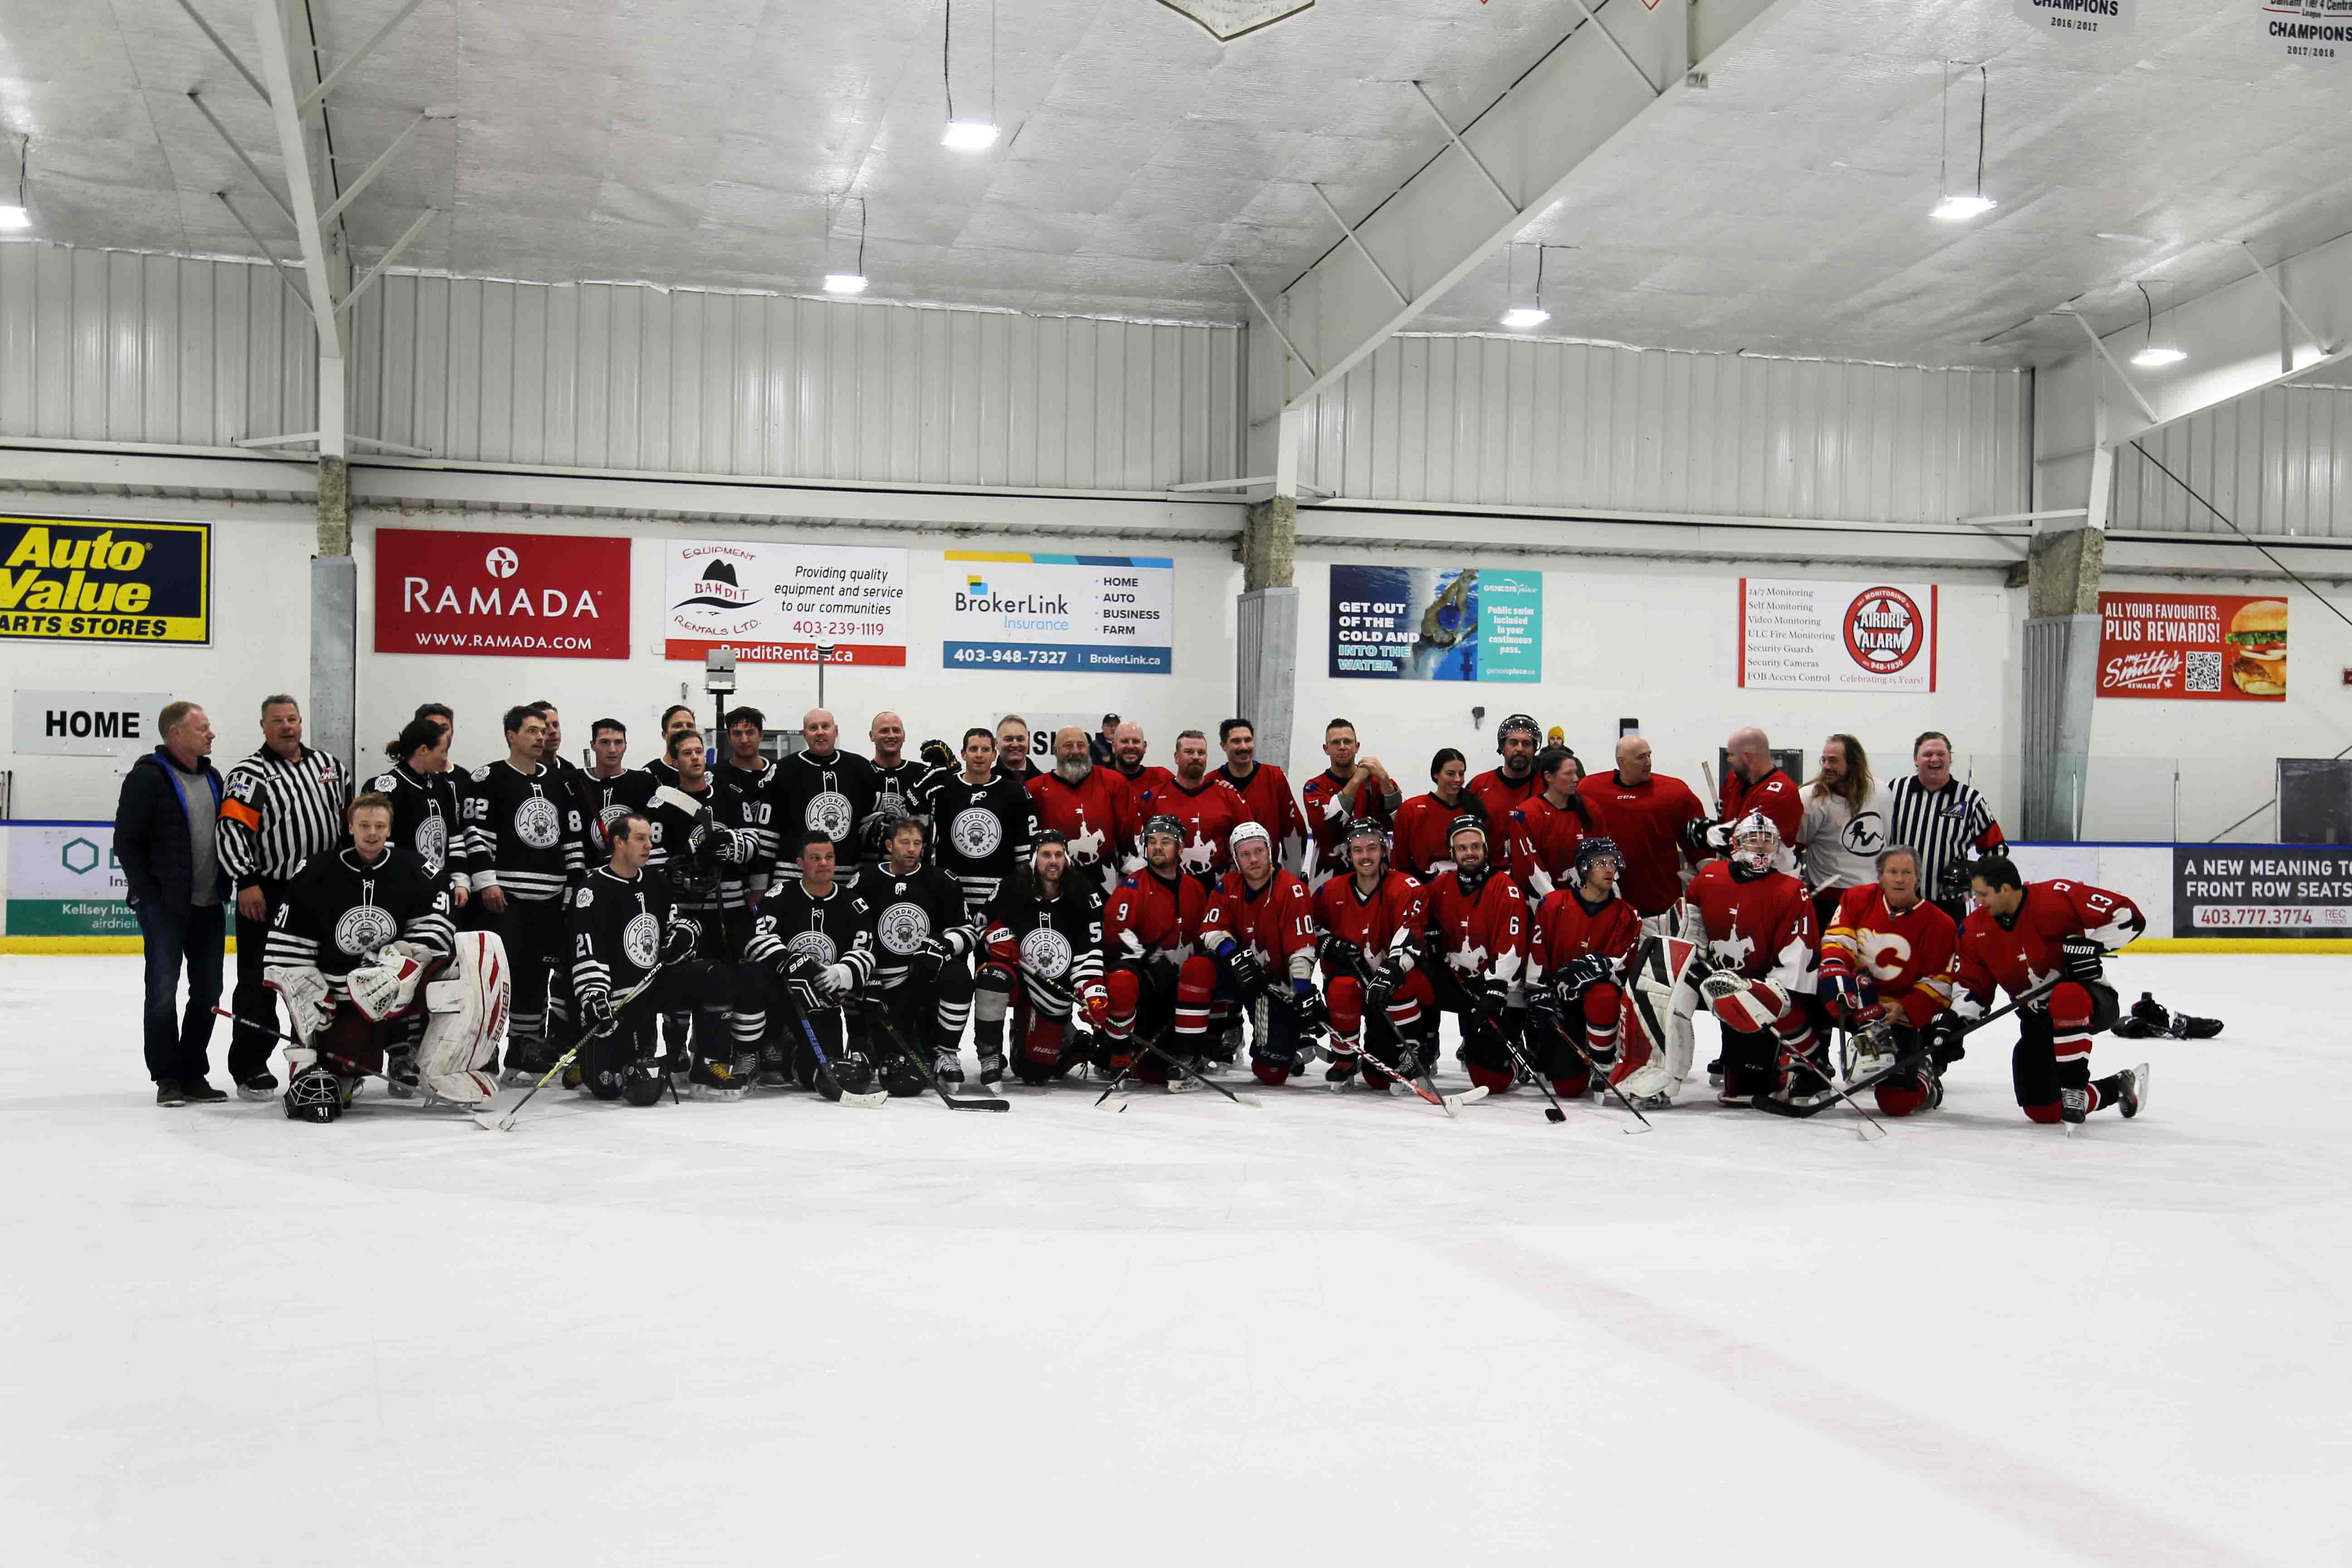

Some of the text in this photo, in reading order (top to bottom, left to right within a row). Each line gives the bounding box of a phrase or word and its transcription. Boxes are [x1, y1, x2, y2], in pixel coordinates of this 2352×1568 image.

[2051, 17, 2098, 32] 2016/2017
[2287, 45, 2335, 57] 2017/2018
[682, 546, 756, 561] EQUIPMENT
[795, 566, 888, 583] Providing quality
[1103, 577, 1139, 587] HOME
[0, 568, 152, 612] Value
[404, 577, 599, 618] RAMADA
[774, 583, 903, 598] equipment and service
[1767, 588, 1813, 598] Monitoring
[955, 592, 1068, 615] BrokerLink
[1103, 593, 1135, 603] AUTO
[781, 601, 891, 615] to our communities
[1103, 609, 1160, 620] BUSINESS
[1338, 602, 1406, 614] GET OUT
[1488, 606, 1512, 614] Public
[1749, 602, 1813, 612] Self Monitoring
[2105, 603, 2220, 621] ALL YOUR FAVOURITES.
[69, 617, 167, 637] STORES
[674, 614, 729, 636] RENTALS
[1004, 616, 1068, 631] Insurance
[1338, 617, 1394, 628] OF THE
[1748, 616, 1822, 627] Video Monitoring
[1860, 612, 1907, 628] AIRDRIE
[792, 621, 884, 636] 403-239-1119
[1103, 625, 1135, 635] FARM
[1748, 630, 1836, 641] ULC Fire Monitoring
[2105, 620, 2220, 643] PLUS REWARDS!
[416, 633, 592, 650] WWW.RAMADA.COM
[1338, 631, 1420, 643] COLD AND
[1861, 632, 1905, 649] ALARM
[1338, 645, 1411, 658] INTO THE
[1748, 644, 1814, 654] Security Guards
[954, 649, 1161, 666] 403-948-7327 BrokerLink.ca
[1338, 659, 1398, 671] WATER.
[1747, 658, 1819, 669] Security Cameras
[1747, 672, 1830, 682] FOB Access Control
[1840, 675, 1887, 685] Celebrating
[46, 710, 140, 738] HOME
[463, 797, 489, 820] 82
[961, 813, 992, 825] AIRDRIE
[959, 839, 994, 853] FIRE DEPT
[2184, 859, 2196, 875] A
[2204, 860, 2244, 875] NEW
[2250, 860, 2332, 876] MEANING
[2186, 882, 2352, 898] FRONT ROW SEATS
[62, 903, 108, 918] Kellsey
[432, 891, 450, 915] 31
[2085, 893, 2113, 914] 13
[274, 902, 290, 928] 31
[349, 912, 385, 925] AIRDRIE
[888, 909, 920, 921] AIRDRIE
[1116, 903, 1128, 921] 9
[2201, 909, 2313, 925] 403.777.3774
[755, 915, 777, 935] 27
[1089, 921, 1102, 943] 5
[1295, 914, 1313, 936] 10
[1509, 916, 1519, 936] 6
[853, 931, 873, 950] 2
[886, 936, 907, 949] FIRE
[1532, 925, 1543, 945] 2
[576, 933, 593, 958] 21
[798, 938, 830, 951] AIRDRIE
[789, 954, 810, 973] BAU
[1230, 949, 1253, 966] CC
[1046, 960, 1064, 975] DEPT
[1529, 991, 1552, 1002] CM
[801, 1019, 827, 1063] BAUER
